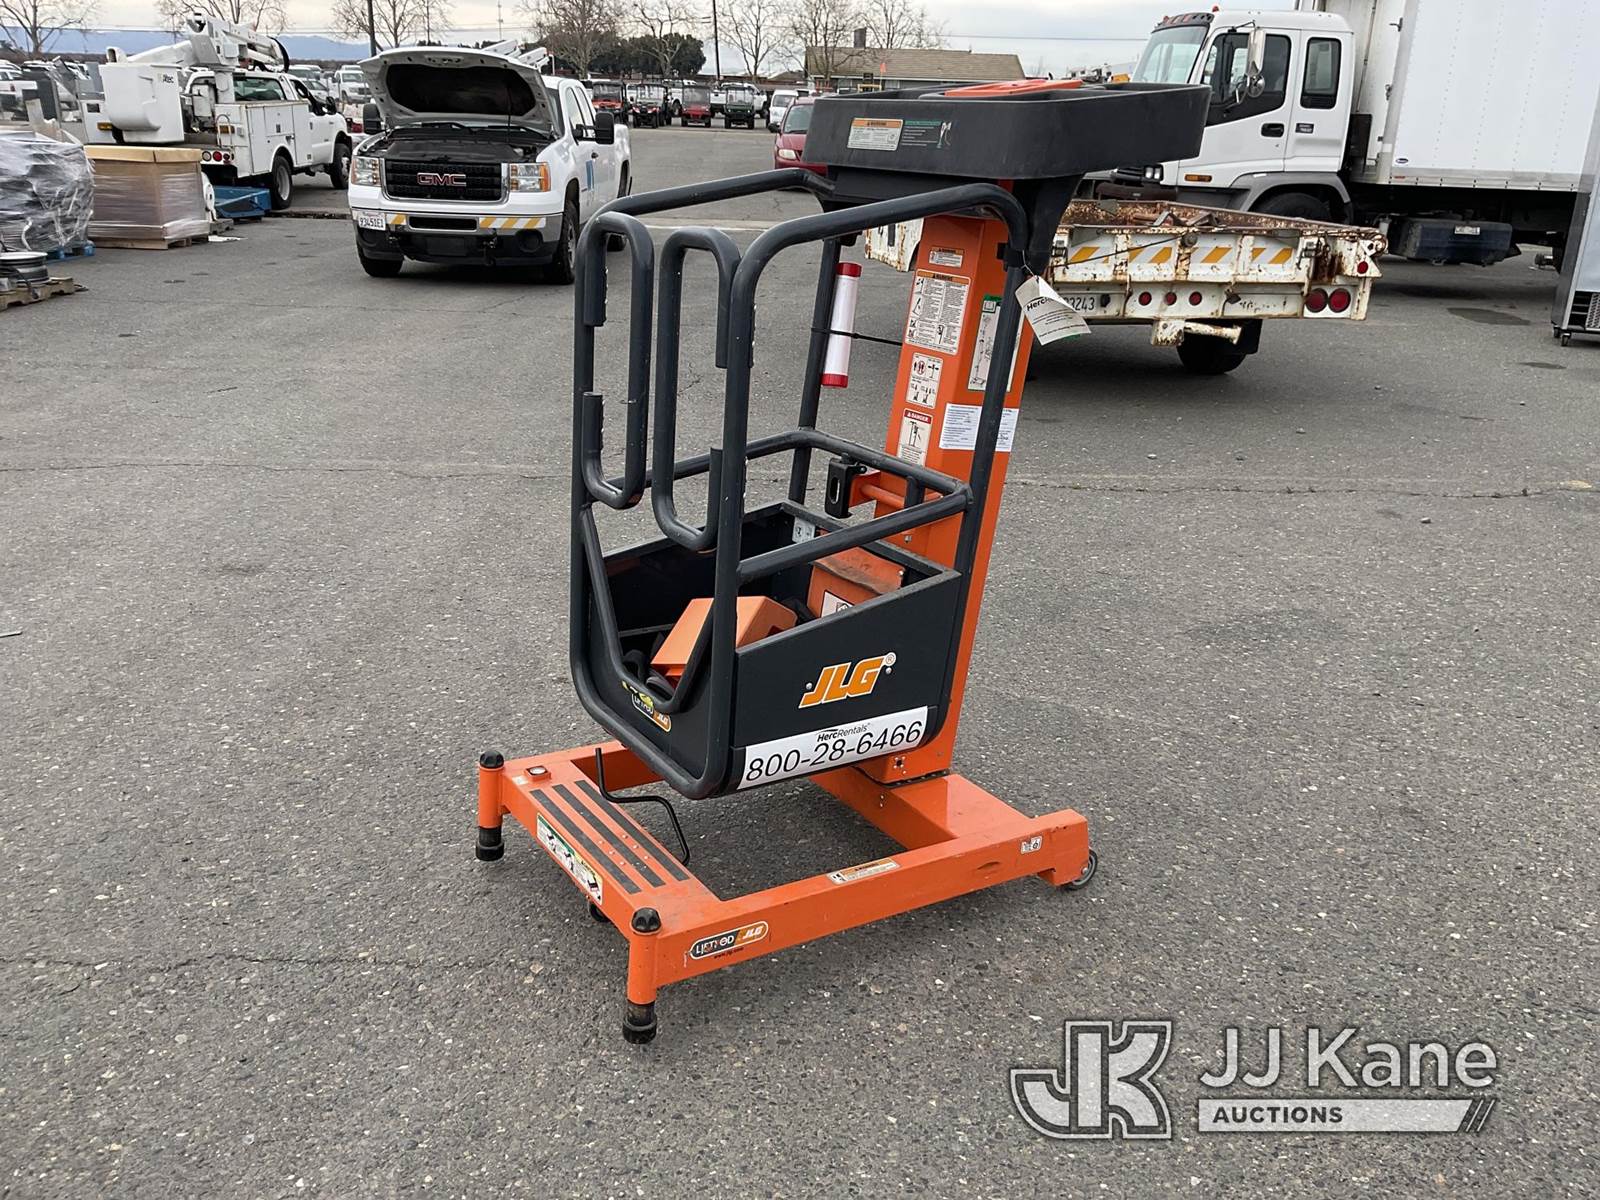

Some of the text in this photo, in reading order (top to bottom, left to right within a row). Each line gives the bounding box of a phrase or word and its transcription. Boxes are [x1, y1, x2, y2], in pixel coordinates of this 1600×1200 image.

[417, 172, 467, 187] GMC
[799, 655, 887, 708] JLG
[746, 720, 922, 781] 800-28-6466
